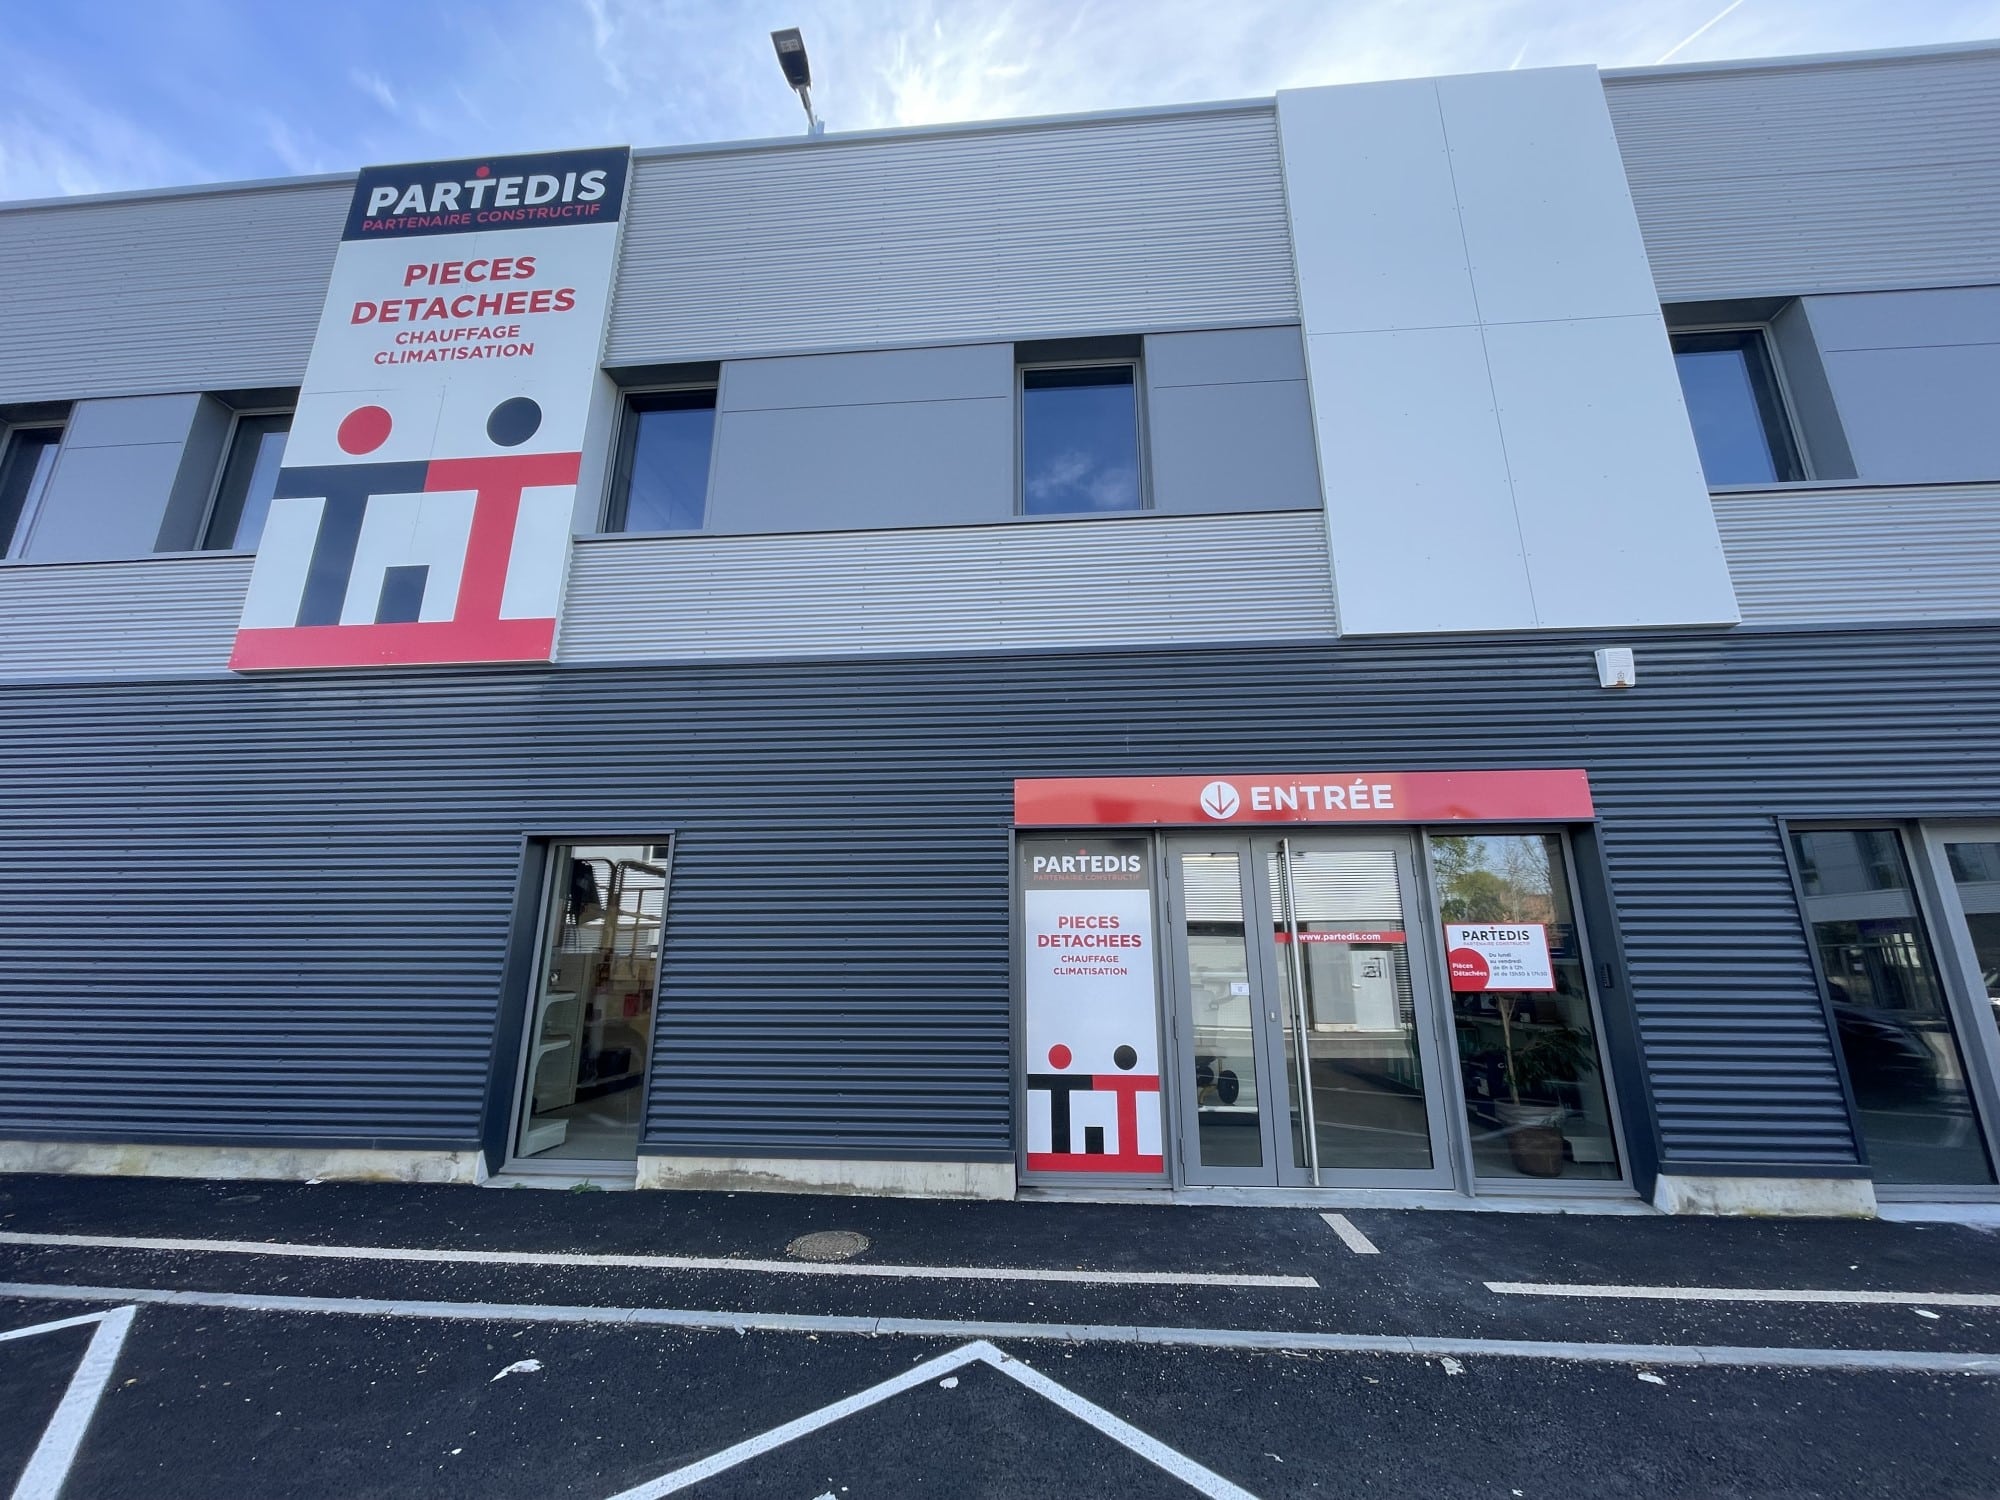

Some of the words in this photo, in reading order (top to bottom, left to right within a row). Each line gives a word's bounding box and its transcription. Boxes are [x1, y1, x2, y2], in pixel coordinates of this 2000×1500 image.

[366, 169, 607, 217] PARTEDIS
[362, 212, 471, 232] PARTENAIRE
[476, 204, 600, 223] CONSTRUCTIF
[404, 256, 536, 287] PIECES
[350, 288, 576, 325] DETACHEES
[395, 325, 520, 345] CHAUFFAGE
[374, 342, 534, 365] CLIMATISATION
[1251, 778, 1394, 811] ENTRÉE
[1033, 855, 1141, 873] PARTEDIS
[1033, 873, 1083, 881] PARTENAIRE
[1085, 873, 1140, 881] CONSTRUCTIF
[1058, 915, 1120, 929] PIECES
[1037, 934, 1142, 948] DETACHEES
[1298, 932, 1381, 942] www.partedis.com
[1462, 930, 1530, 941] PARTEDIS
[1060, 955, 1119, 963] CHAUFFAGE
[1053, 967, 1128, 976] CLIMATISATION
